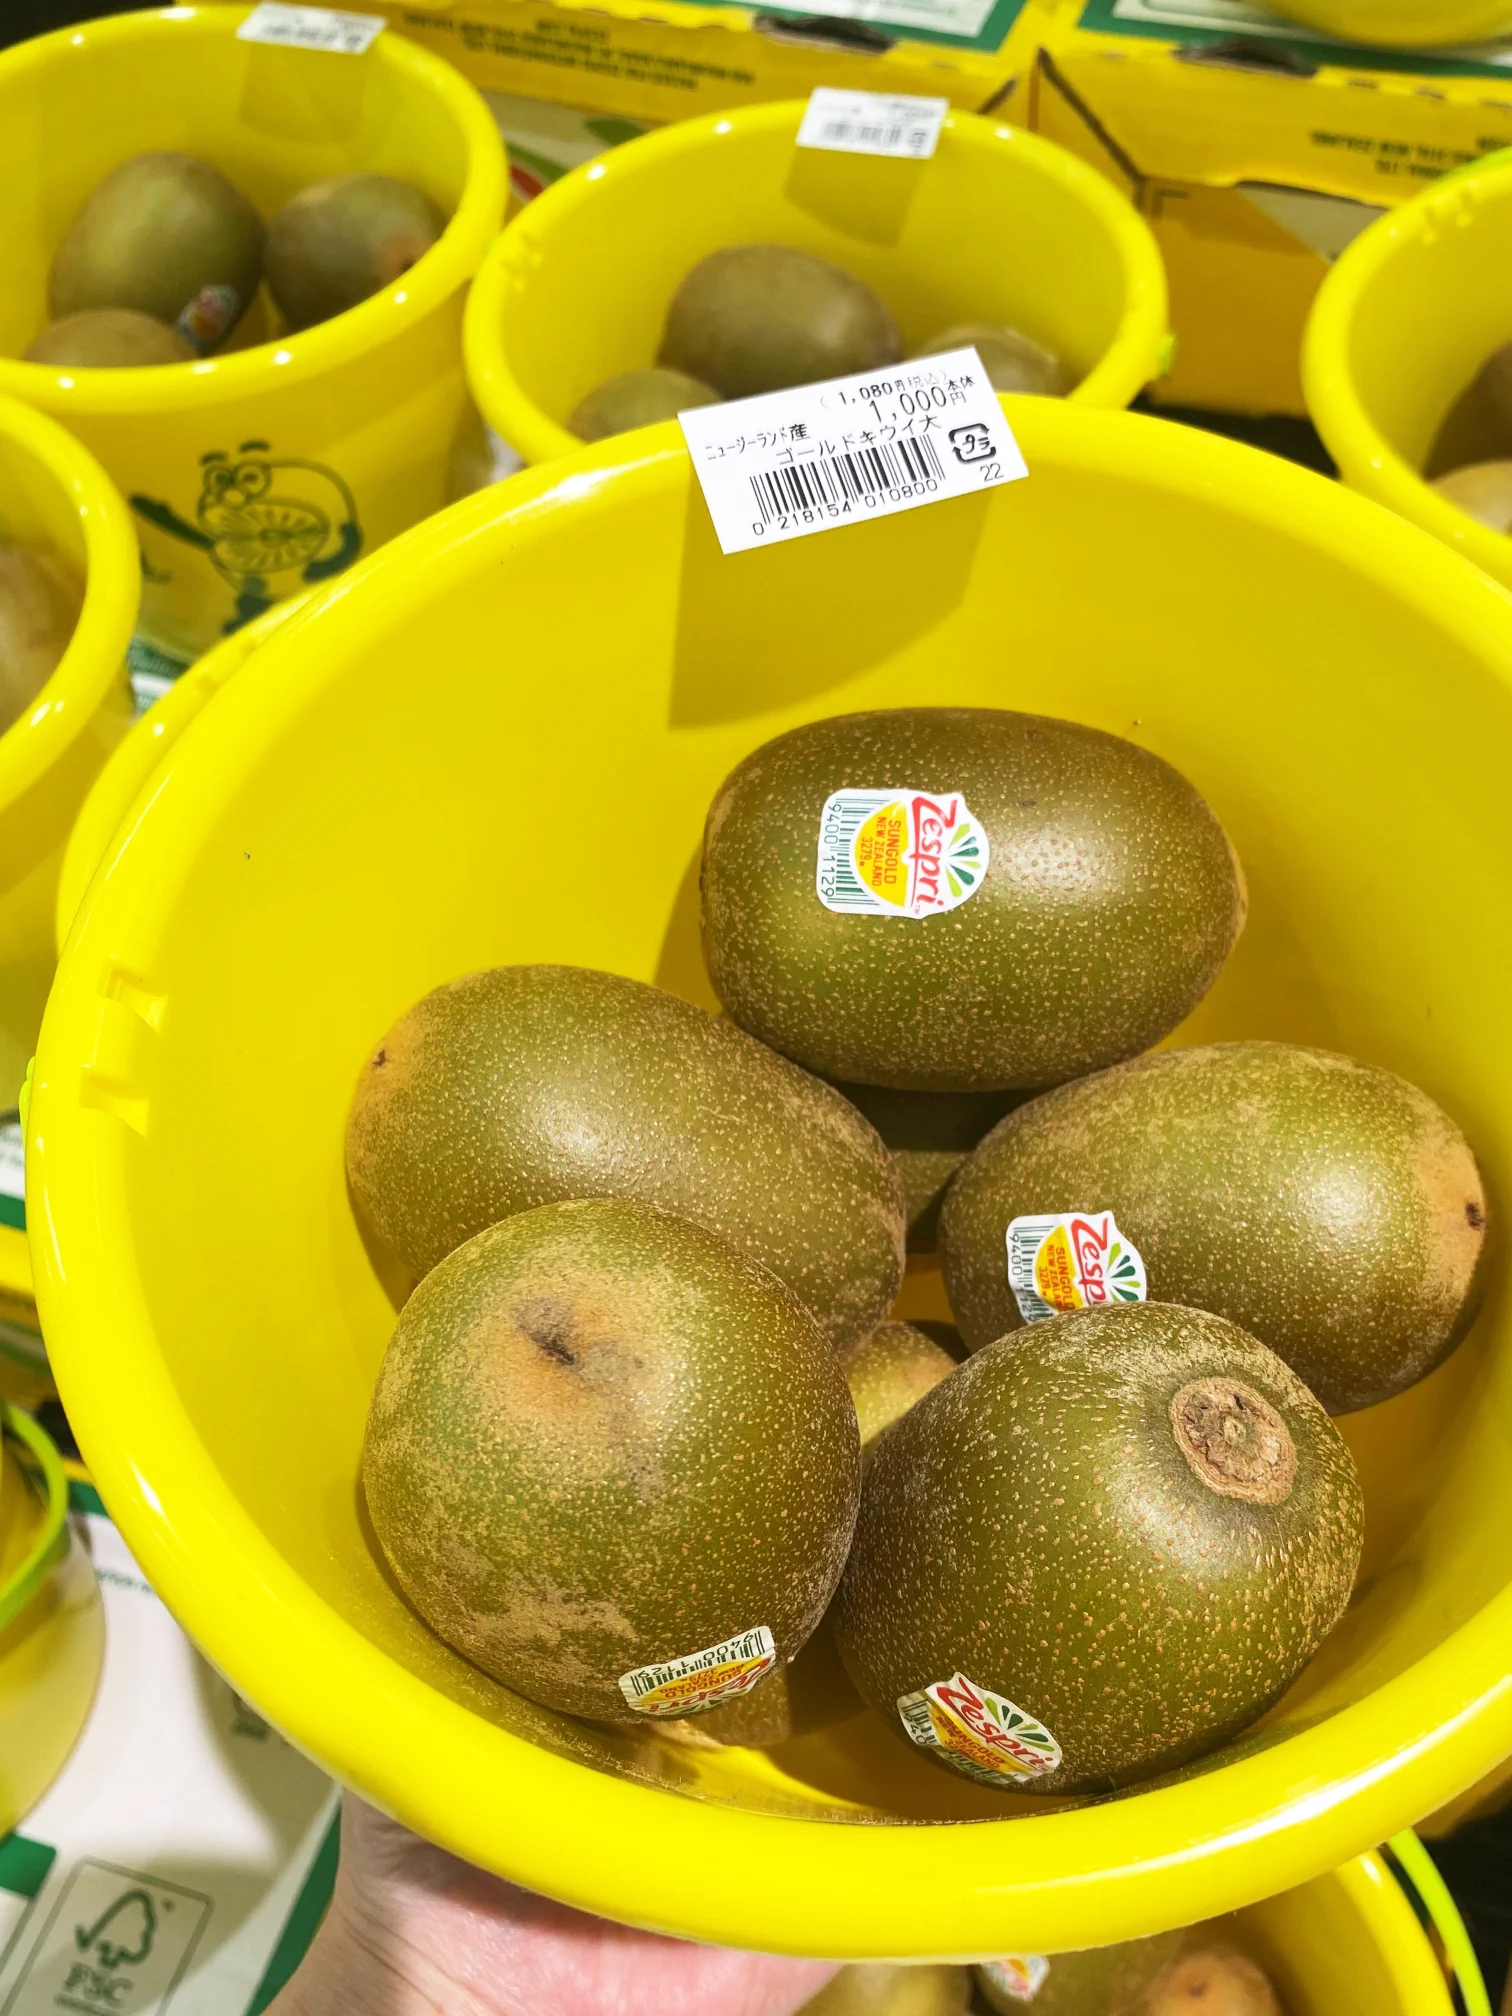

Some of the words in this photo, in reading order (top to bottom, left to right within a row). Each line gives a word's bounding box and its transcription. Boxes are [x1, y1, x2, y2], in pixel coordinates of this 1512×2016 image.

[705, 424, 811, 460] ニュージーランド産
[776, 413, 942, 465] ゴールドキウイ大
[979, 462, 1005, 483] 22
[752, 521, 765, 536] 0
[777, 500, 852, 530] 218154
[864, 478, 939, 508] 010800
[823, 803, 842, 845] 9400
[875, 816, 887, 838] NEW
[861, 836, 873, 861] 3279
[871, 841, 885, 887] ZEALAND
[883, 820, 902, 885] SUNGOLD
[908, 796, 958, 907] Zespri
[820, 855, 836, 898] 1129
[1009, 1233, 1023, 1276] 9400
[1047, 1244, 1056, 1267] NEW
[1070, 1218, 1109, 1305] Zesp
[702, 1632, 754, 1661] 9400
[637, 1660, 690, 1680] 1129
[936, 1676, 1054, 1771] Zespri
[936, 1716, 957, 1738] NEW
[955, 1739, 1000, 1769] ZEALAND
